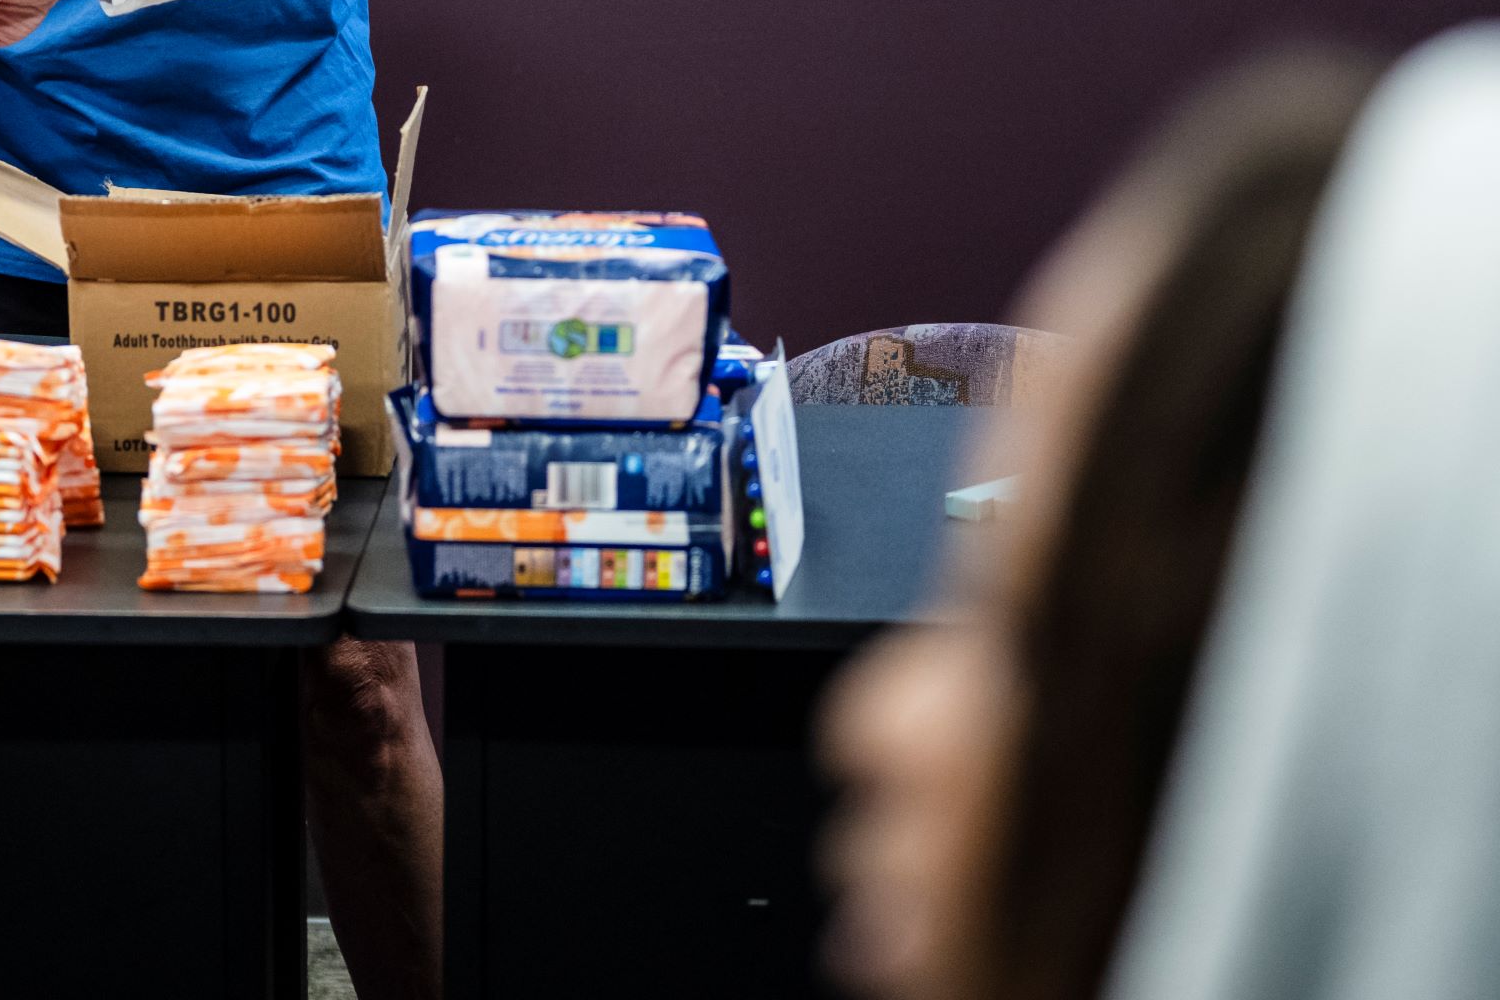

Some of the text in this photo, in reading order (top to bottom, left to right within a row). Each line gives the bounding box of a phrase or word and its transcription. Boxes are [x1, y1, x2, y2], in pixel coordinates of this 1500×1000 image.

[155, 301, 296, 323] TBRG1-100
[113, 334, 148, 348] Adult
[152, 334, 226, 348] Toothbrush
